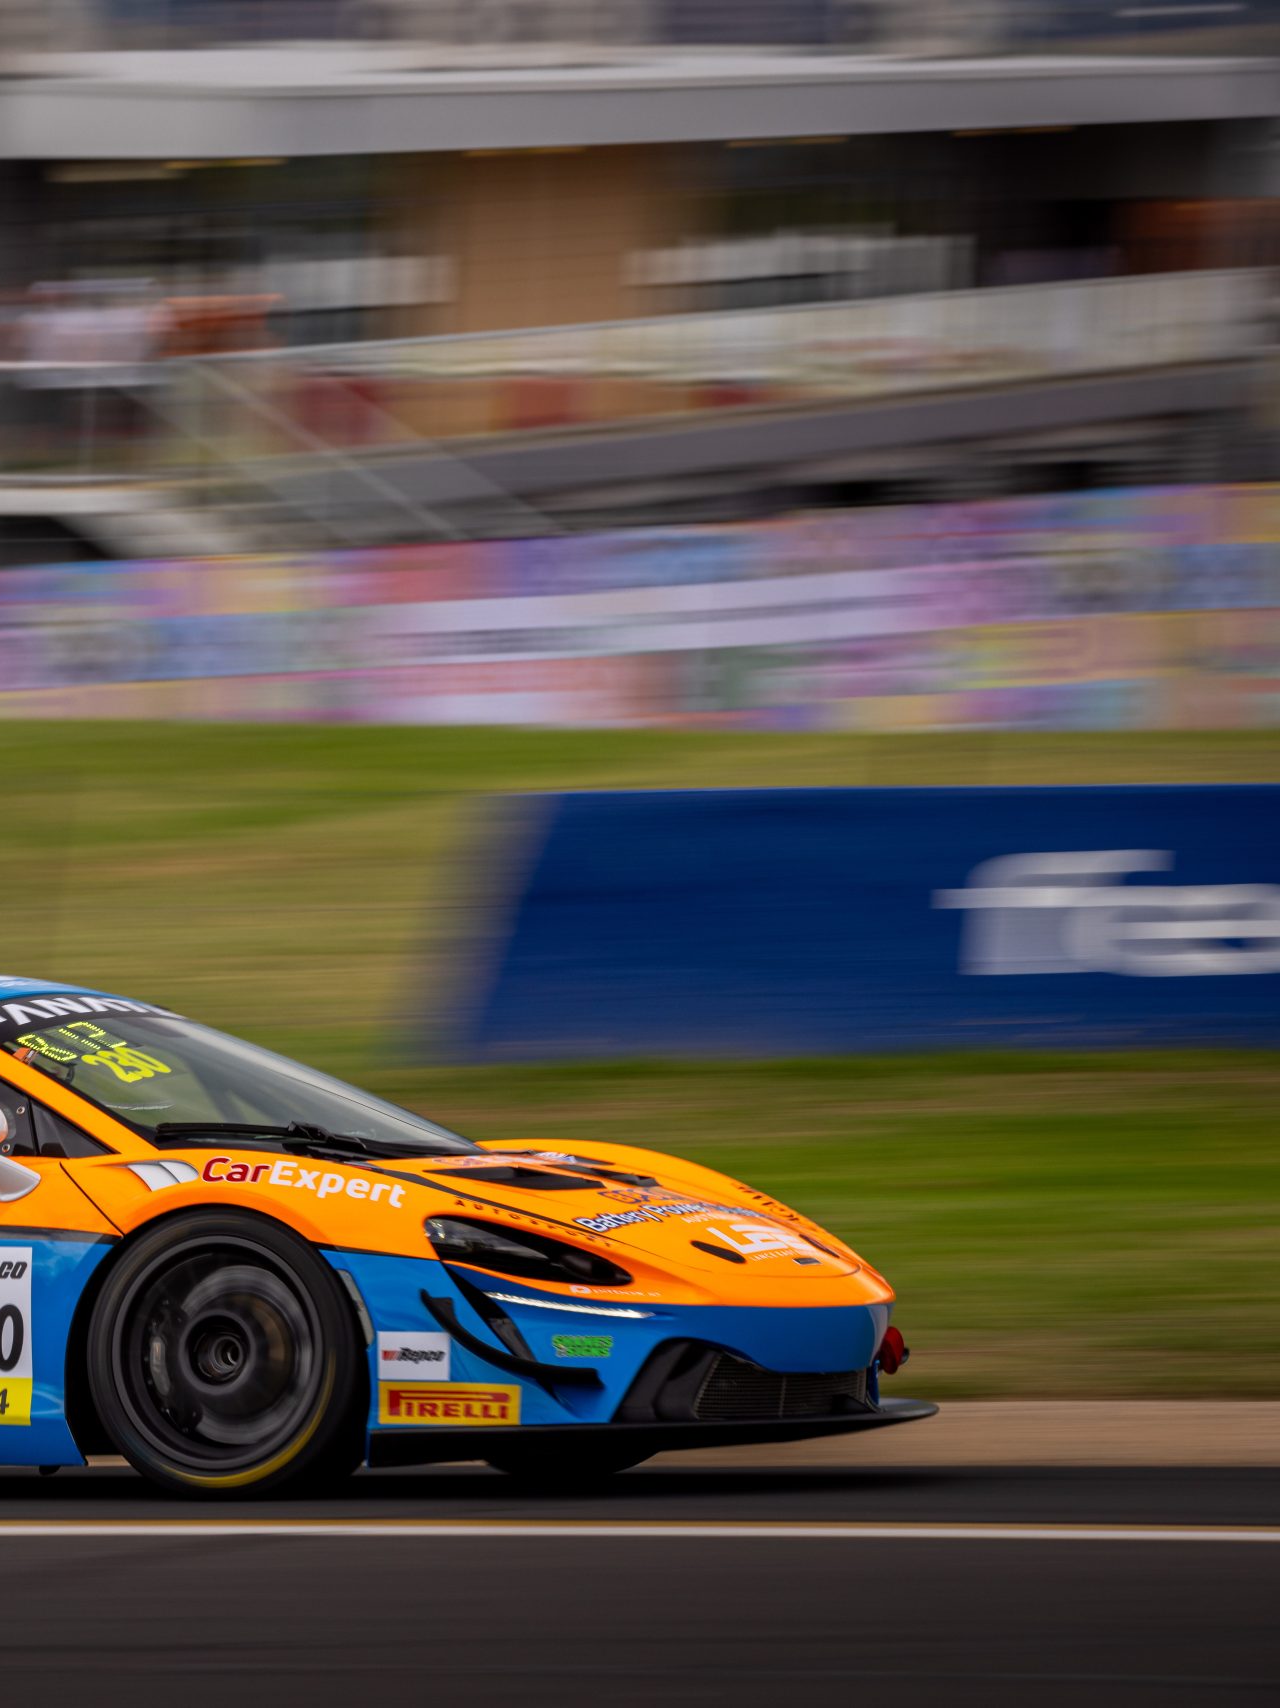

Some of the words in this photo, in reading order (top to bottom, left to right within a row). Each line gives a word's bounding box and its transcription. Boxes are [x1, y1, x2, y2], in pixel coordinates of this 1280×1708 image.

[81, 1045, 172, 1083] 230
[202, 1157, 406, 1208] CarExpert
[572, 1209, 663, 1232] Battery
[398, 1347, 445, 1364] Repco
[387, 1390, 511, 1420] PIRELLI
